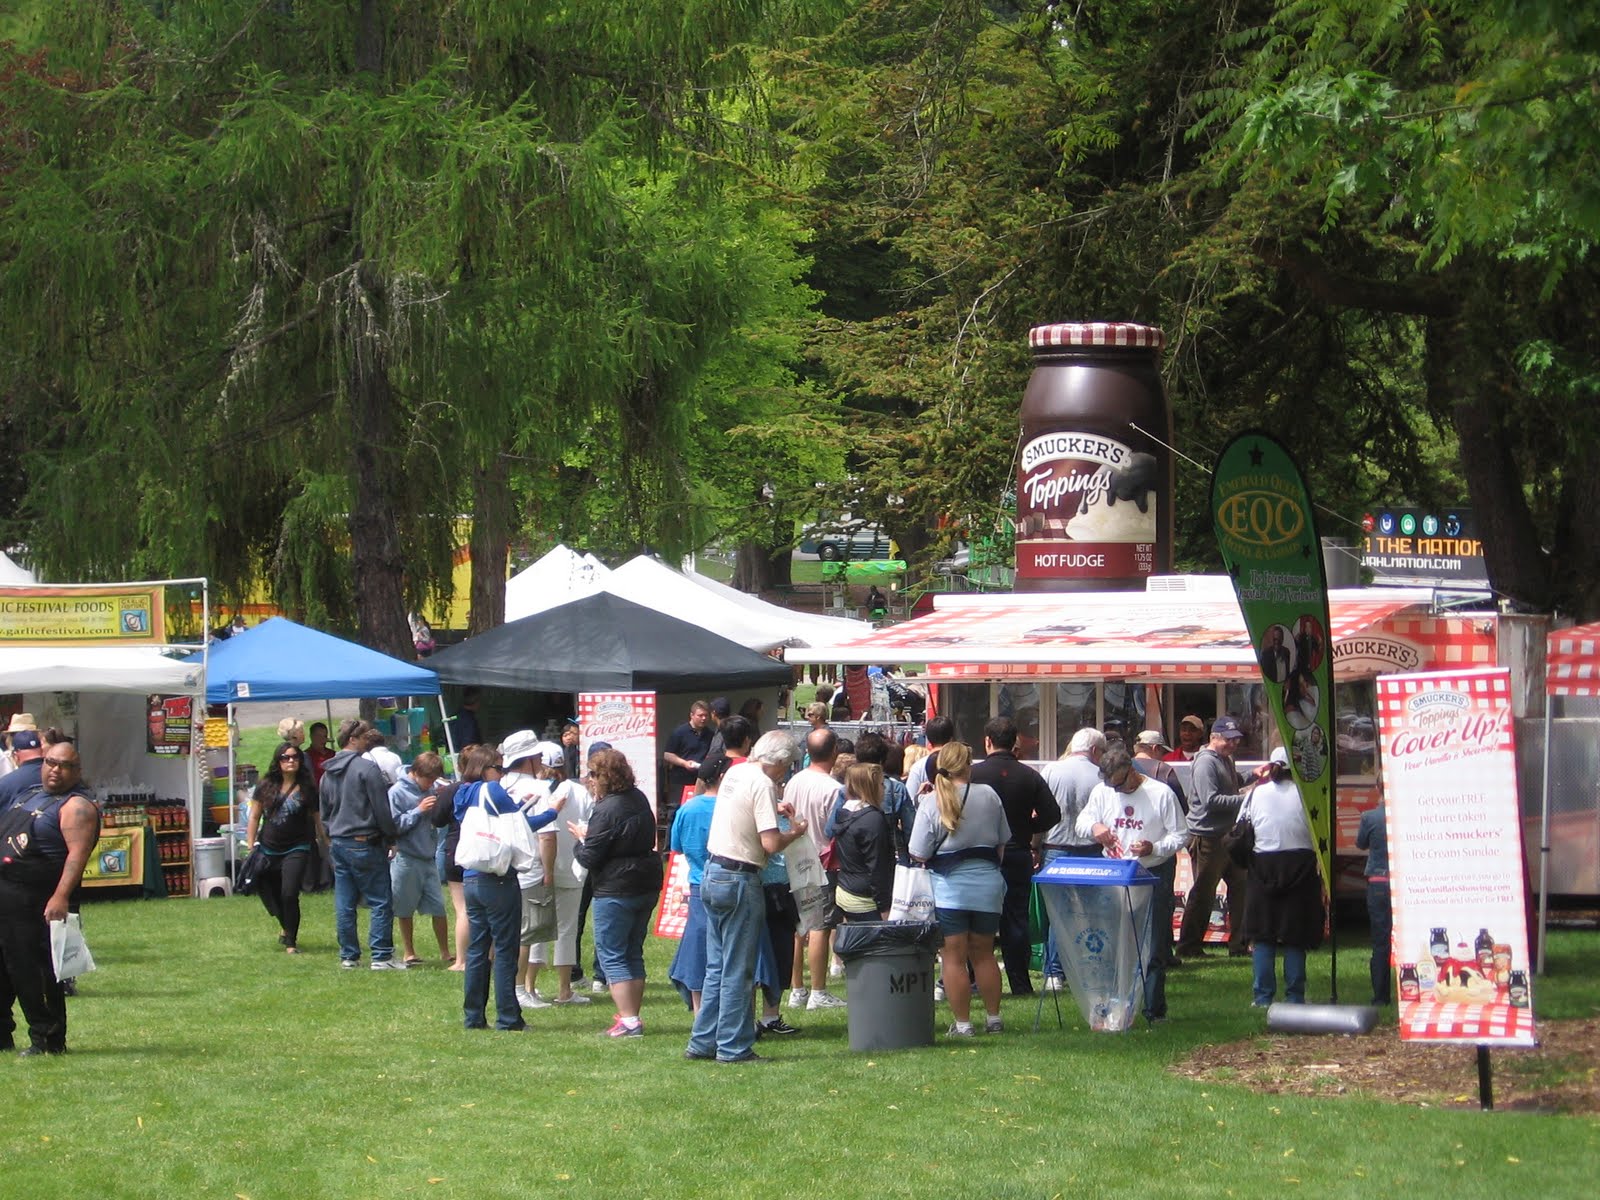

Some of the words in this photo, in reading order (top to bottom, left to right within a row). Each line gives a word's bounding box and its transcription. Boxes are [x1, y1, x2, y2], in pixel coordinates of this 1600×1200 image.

[1025, 437, 1125, 465] SMUCKER'S
[1024, 468, 1113, 510] Toppings
[1376, 537, 1412, 554] THE
[1034, 554, 1057, 567] HOT
[1060, 554, 1105, 567] FUDGE
[16, 601, 68, 613] FESTIVAL
[74, 601, 114, 613] FOODS
[1333, 641, 1410, 663] MUCKER'S
[585, 722, 624, 738] Cover
[625, 712, 653, 733] Up!
[1412, 708, 1460, 728] Toppings
[1390, 728, 1457, 758] Cover
[1461, 706, 1508, 745] Up!
[1417, 796, 1437, 807] Get
[1436, 796, 1459, 808] your
[1113, 818, 1143, 830] JESUS
[1419, 813, 1457, 826] picture
[1458, 811, 1487, 823] taken
[1405, 831, 1436, 842] inside
[1436, 833, 1444, 841] a
[1412, 849, 1426, 860] Ice
[1427, 848, 1461, 859] Cream
[1462, 845, 1500, 857] Sundae
[889, 971, 929, 994] MPT
